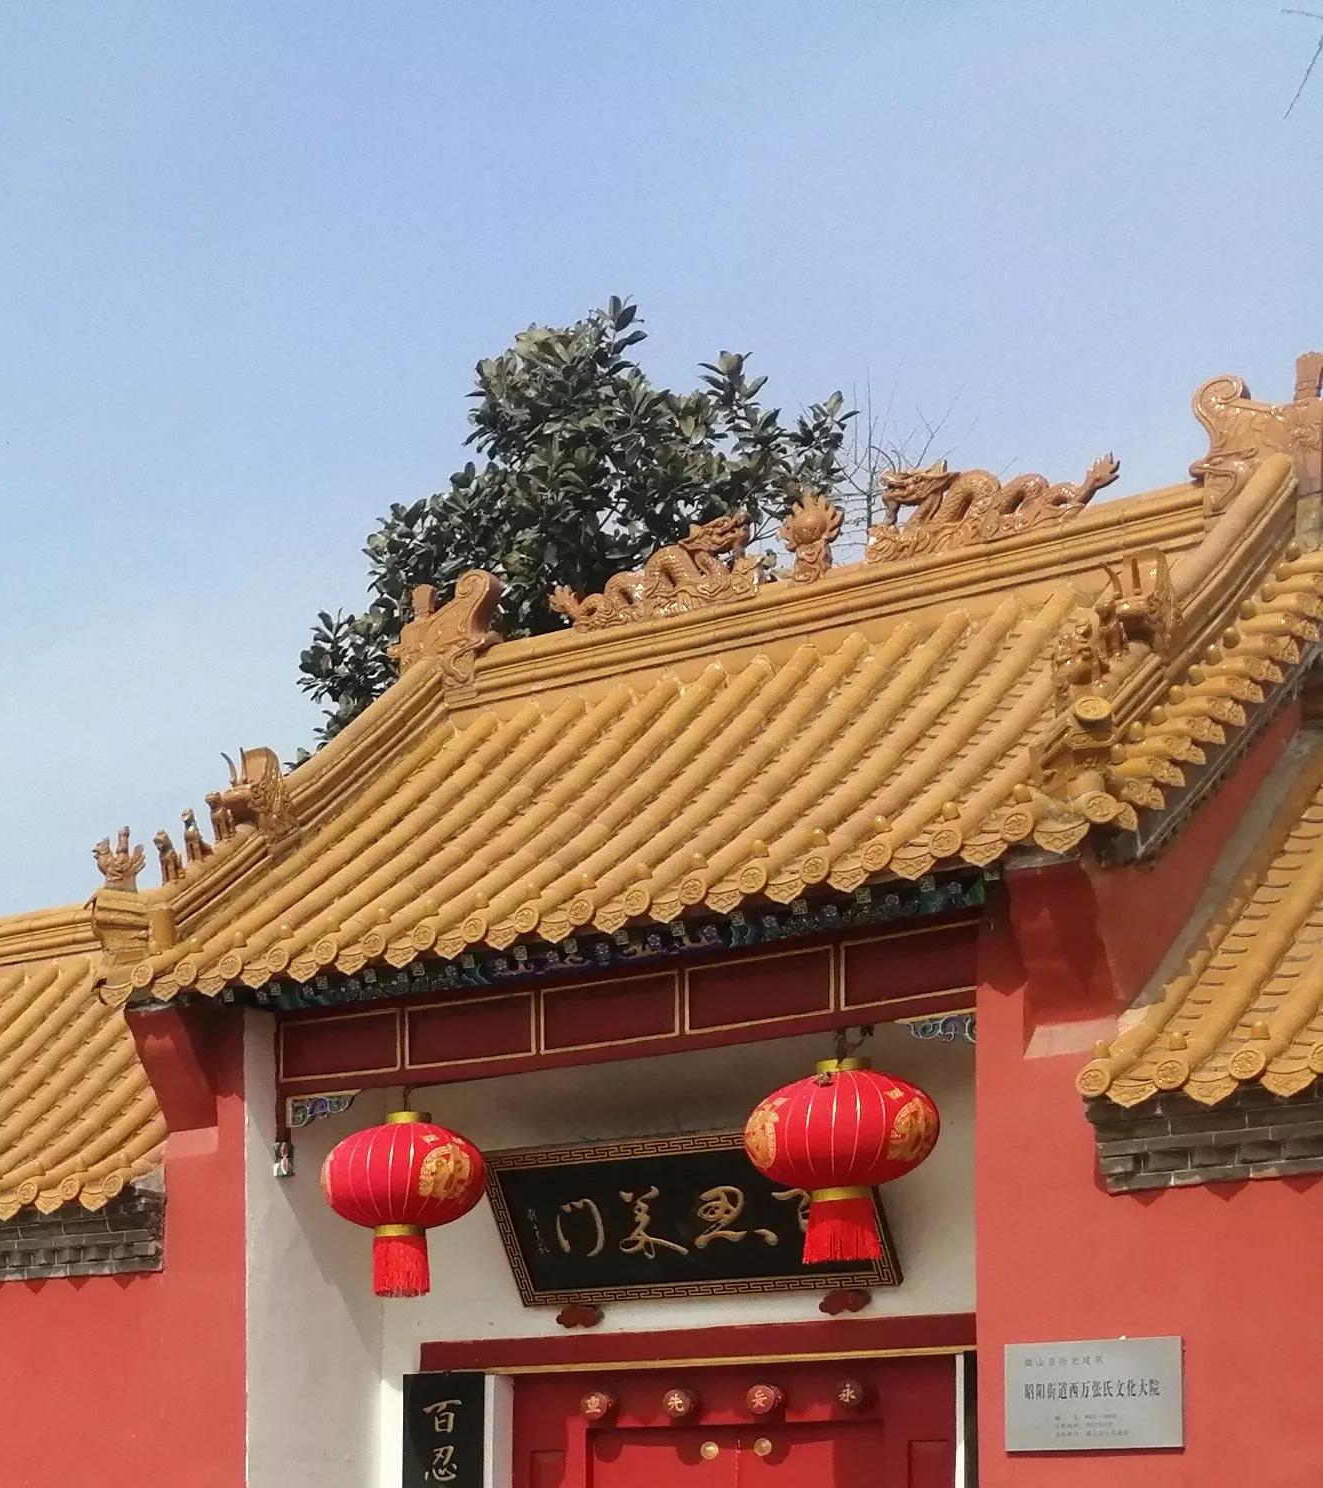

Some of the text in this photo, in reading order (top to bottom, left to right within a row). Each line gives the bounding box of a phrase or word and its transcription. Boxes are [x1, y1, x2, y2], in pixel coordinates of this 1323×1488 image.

[1023, 1379, 1160, 1400] 昭阳街道西万张氏文化大院
